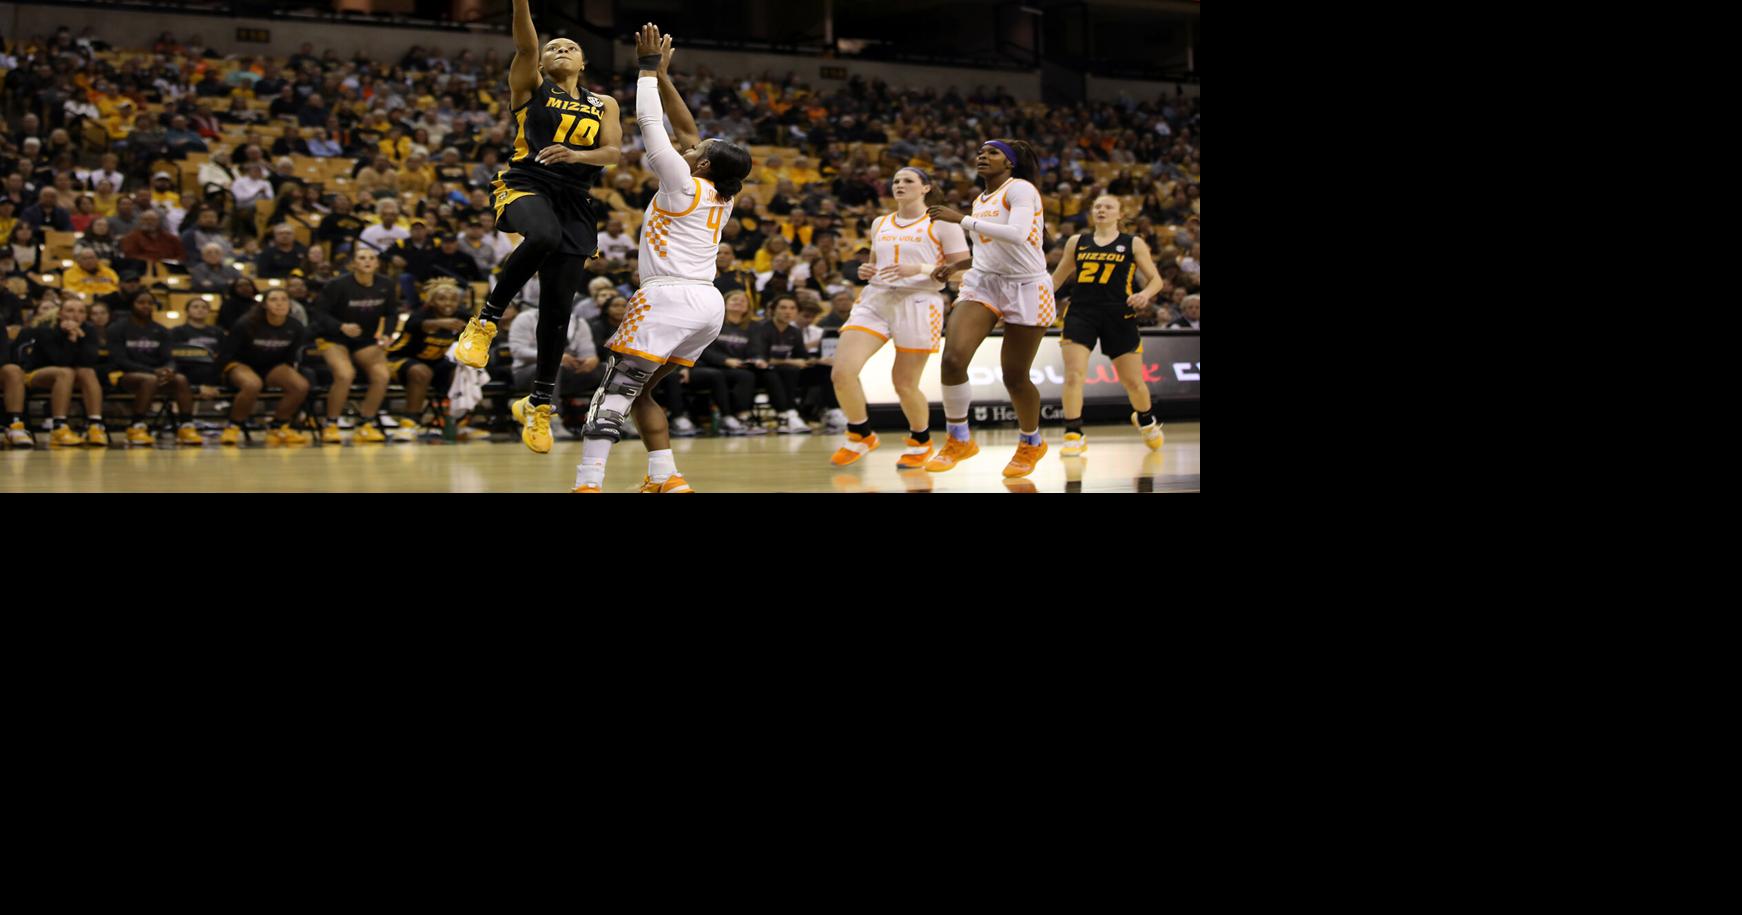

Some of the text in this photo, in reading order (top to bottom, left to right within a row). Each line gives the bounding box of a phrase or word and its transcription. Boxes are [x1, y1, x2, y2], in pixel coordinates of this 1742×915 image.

[552, 113, 600, 146] 10
[706, 207, 724, 244] 4
[894, 244, 900, 264] 1
[1077, 252, 1125, 262] MIZZOU
[1078, 262, 1116, 284] 21
